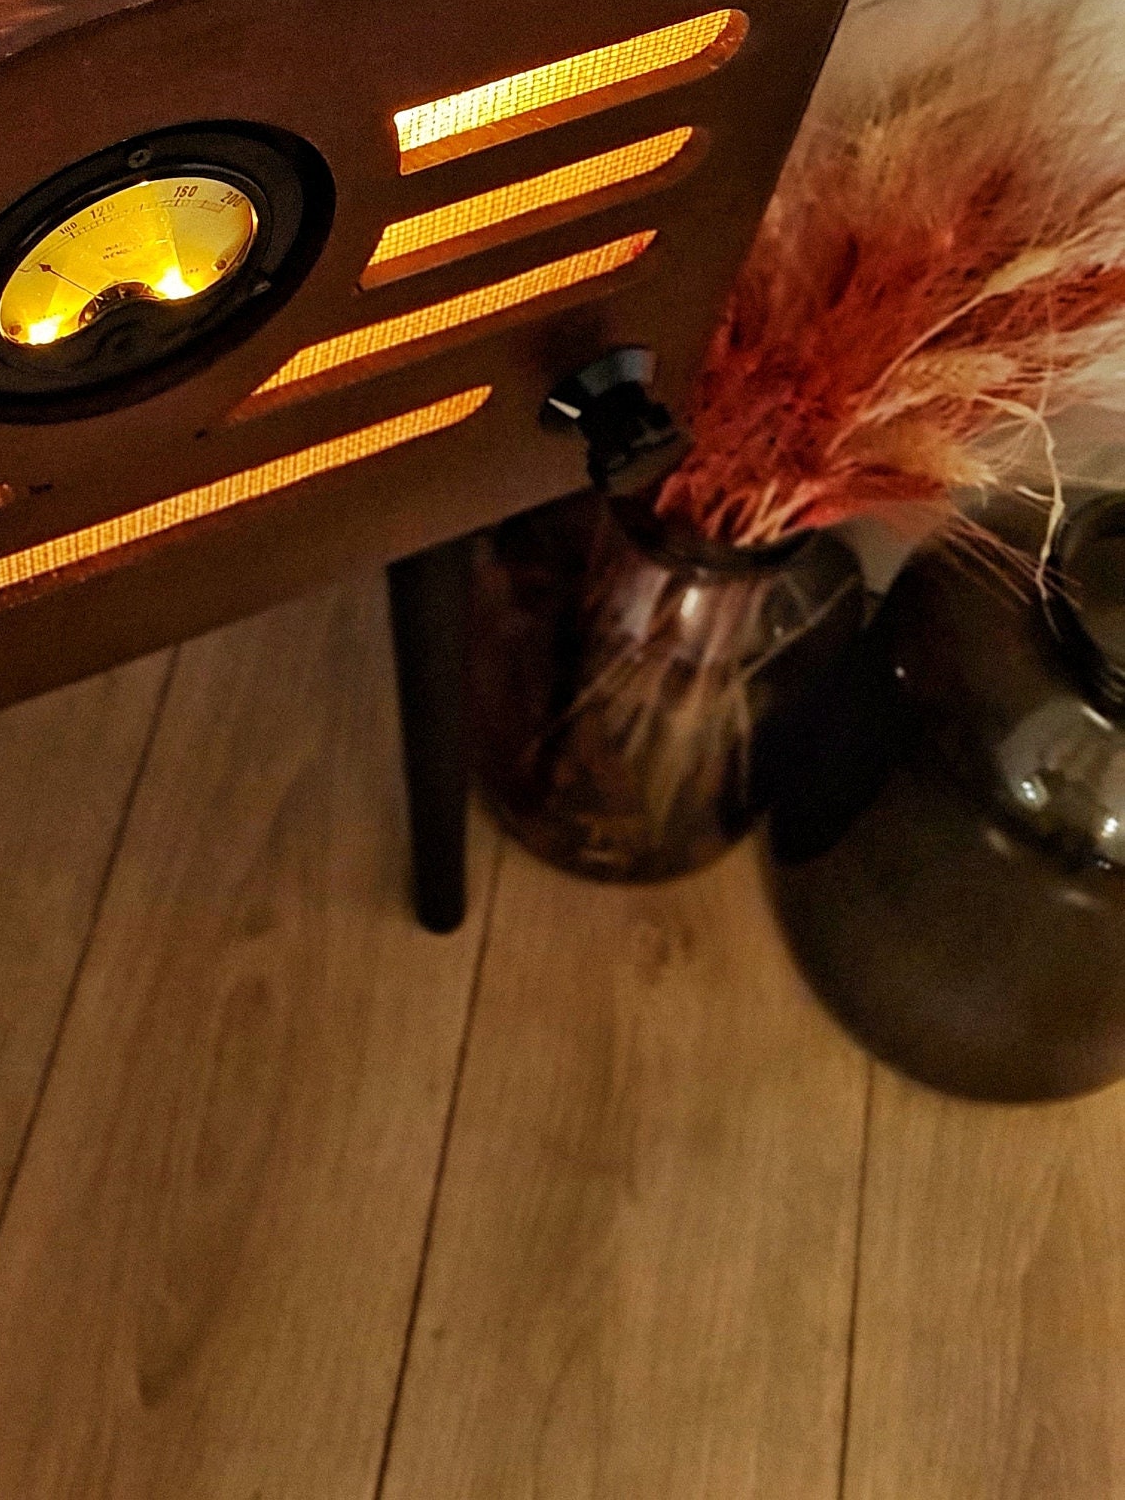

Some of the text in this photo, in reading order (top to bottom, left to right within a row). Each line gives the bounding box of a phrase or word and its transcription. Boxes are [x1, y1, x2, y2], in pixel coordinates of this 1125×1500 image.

[59, 222, 78, 236] 100
[90, 201, 115, 219] 120
[220, 190, 246, 208] 200
